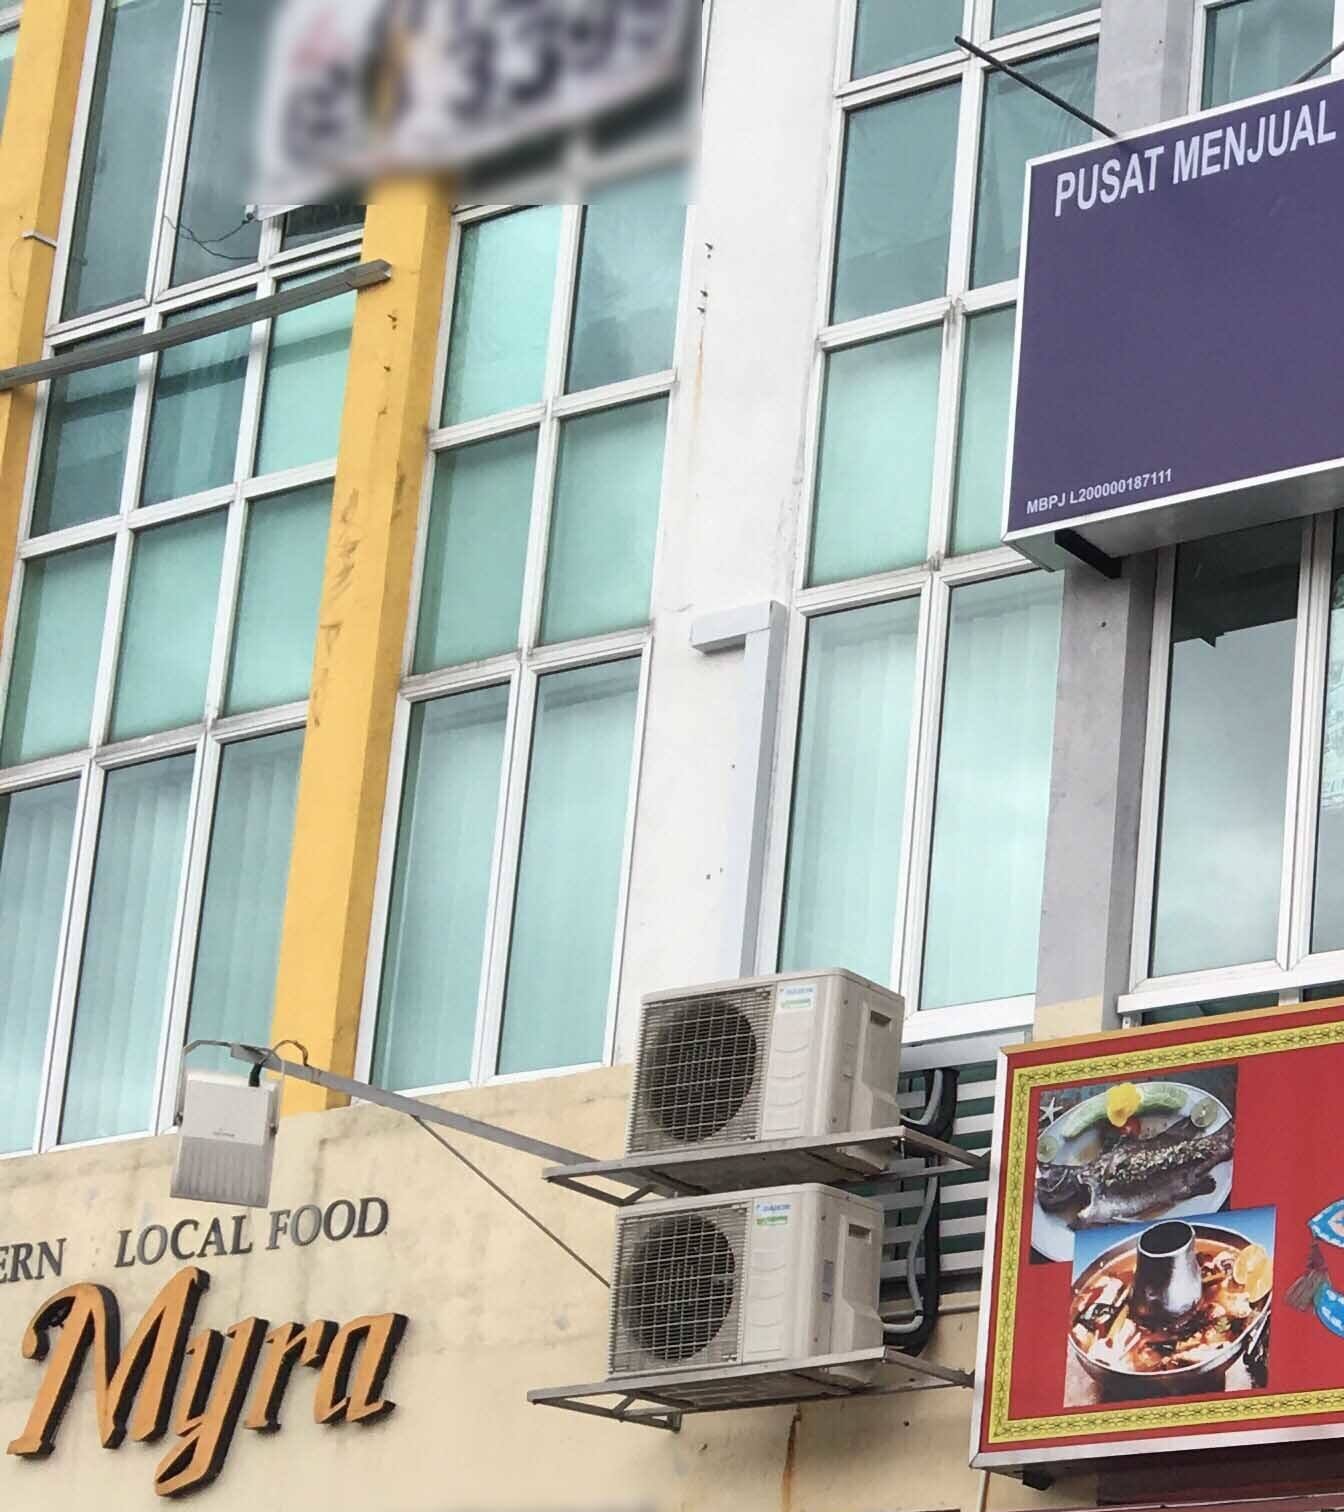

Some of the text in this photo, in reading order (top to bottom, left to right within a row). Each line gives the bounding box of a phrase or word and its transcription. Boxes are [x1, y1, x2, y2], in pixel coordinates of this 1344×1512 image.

[1054, 145, 1164, 217] PUSAT
[1172, 98, 1337, 182] MENJUAL
[1026, 467, 1172, 515] MBPJ L200000187111
[115, 1214, 254, 1268] LOCAL
[266, 1197, 390, 1250] FOOD
[6, 1266, 408, 1497] Myra
